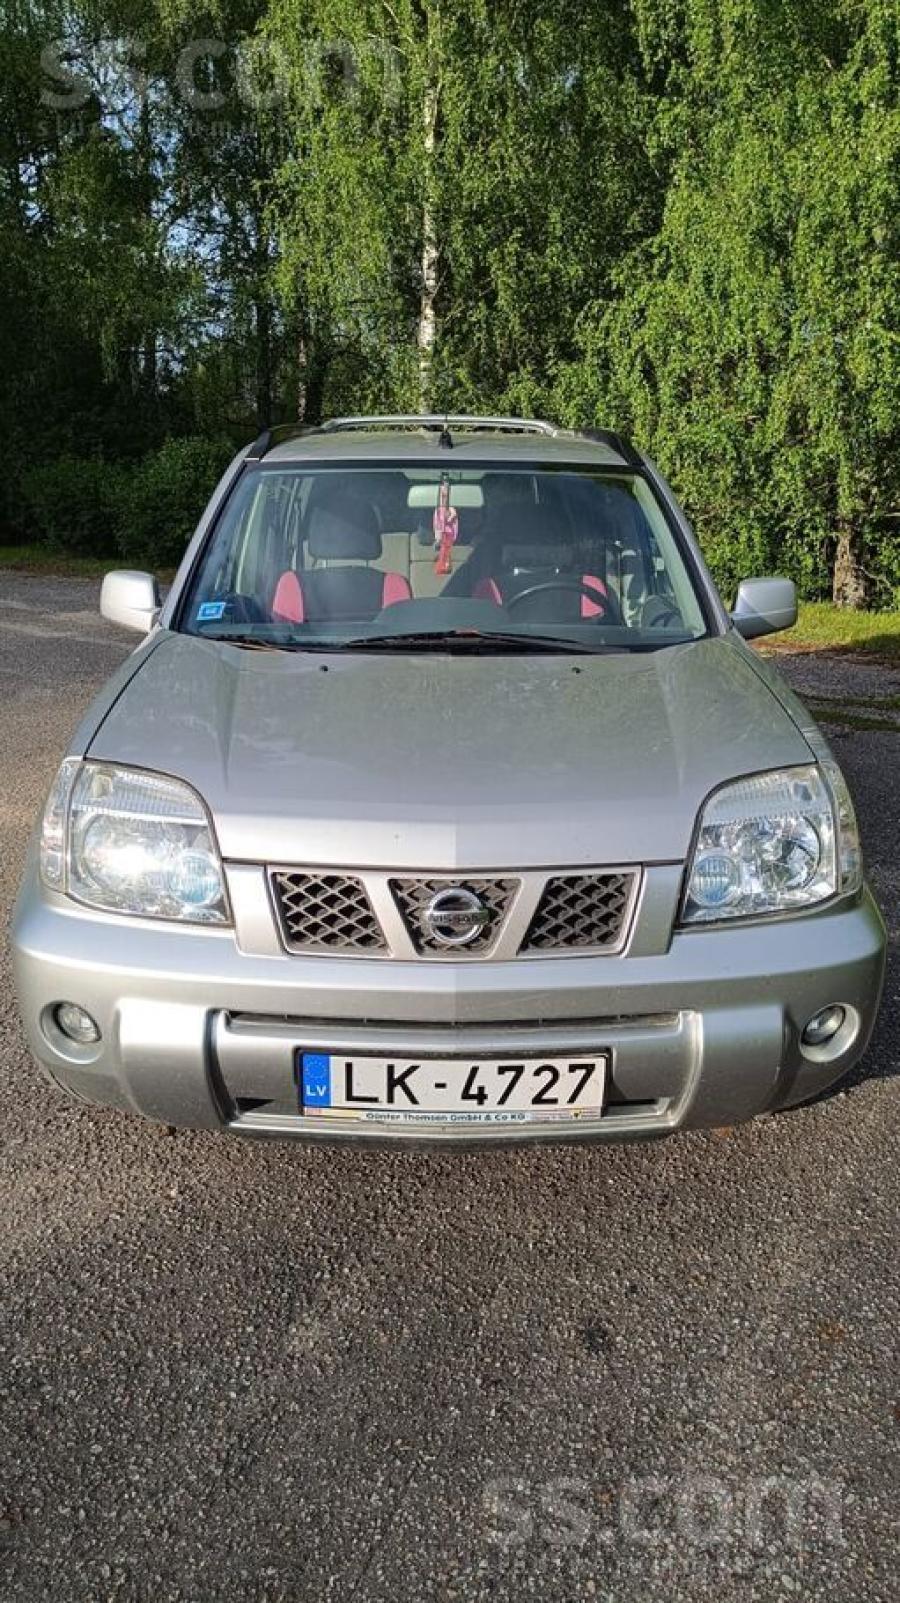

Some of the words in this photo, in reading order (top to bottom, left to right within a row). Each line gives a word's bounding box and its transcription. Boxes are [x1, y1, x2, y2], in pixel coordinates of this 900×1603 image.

[344, 1061, 597, 1105] LK-4727
[305, 1084, 327, 1097] LV
[450, 1113, 482, 1121] GmbH
[484, 1113, 492, 1121] &
